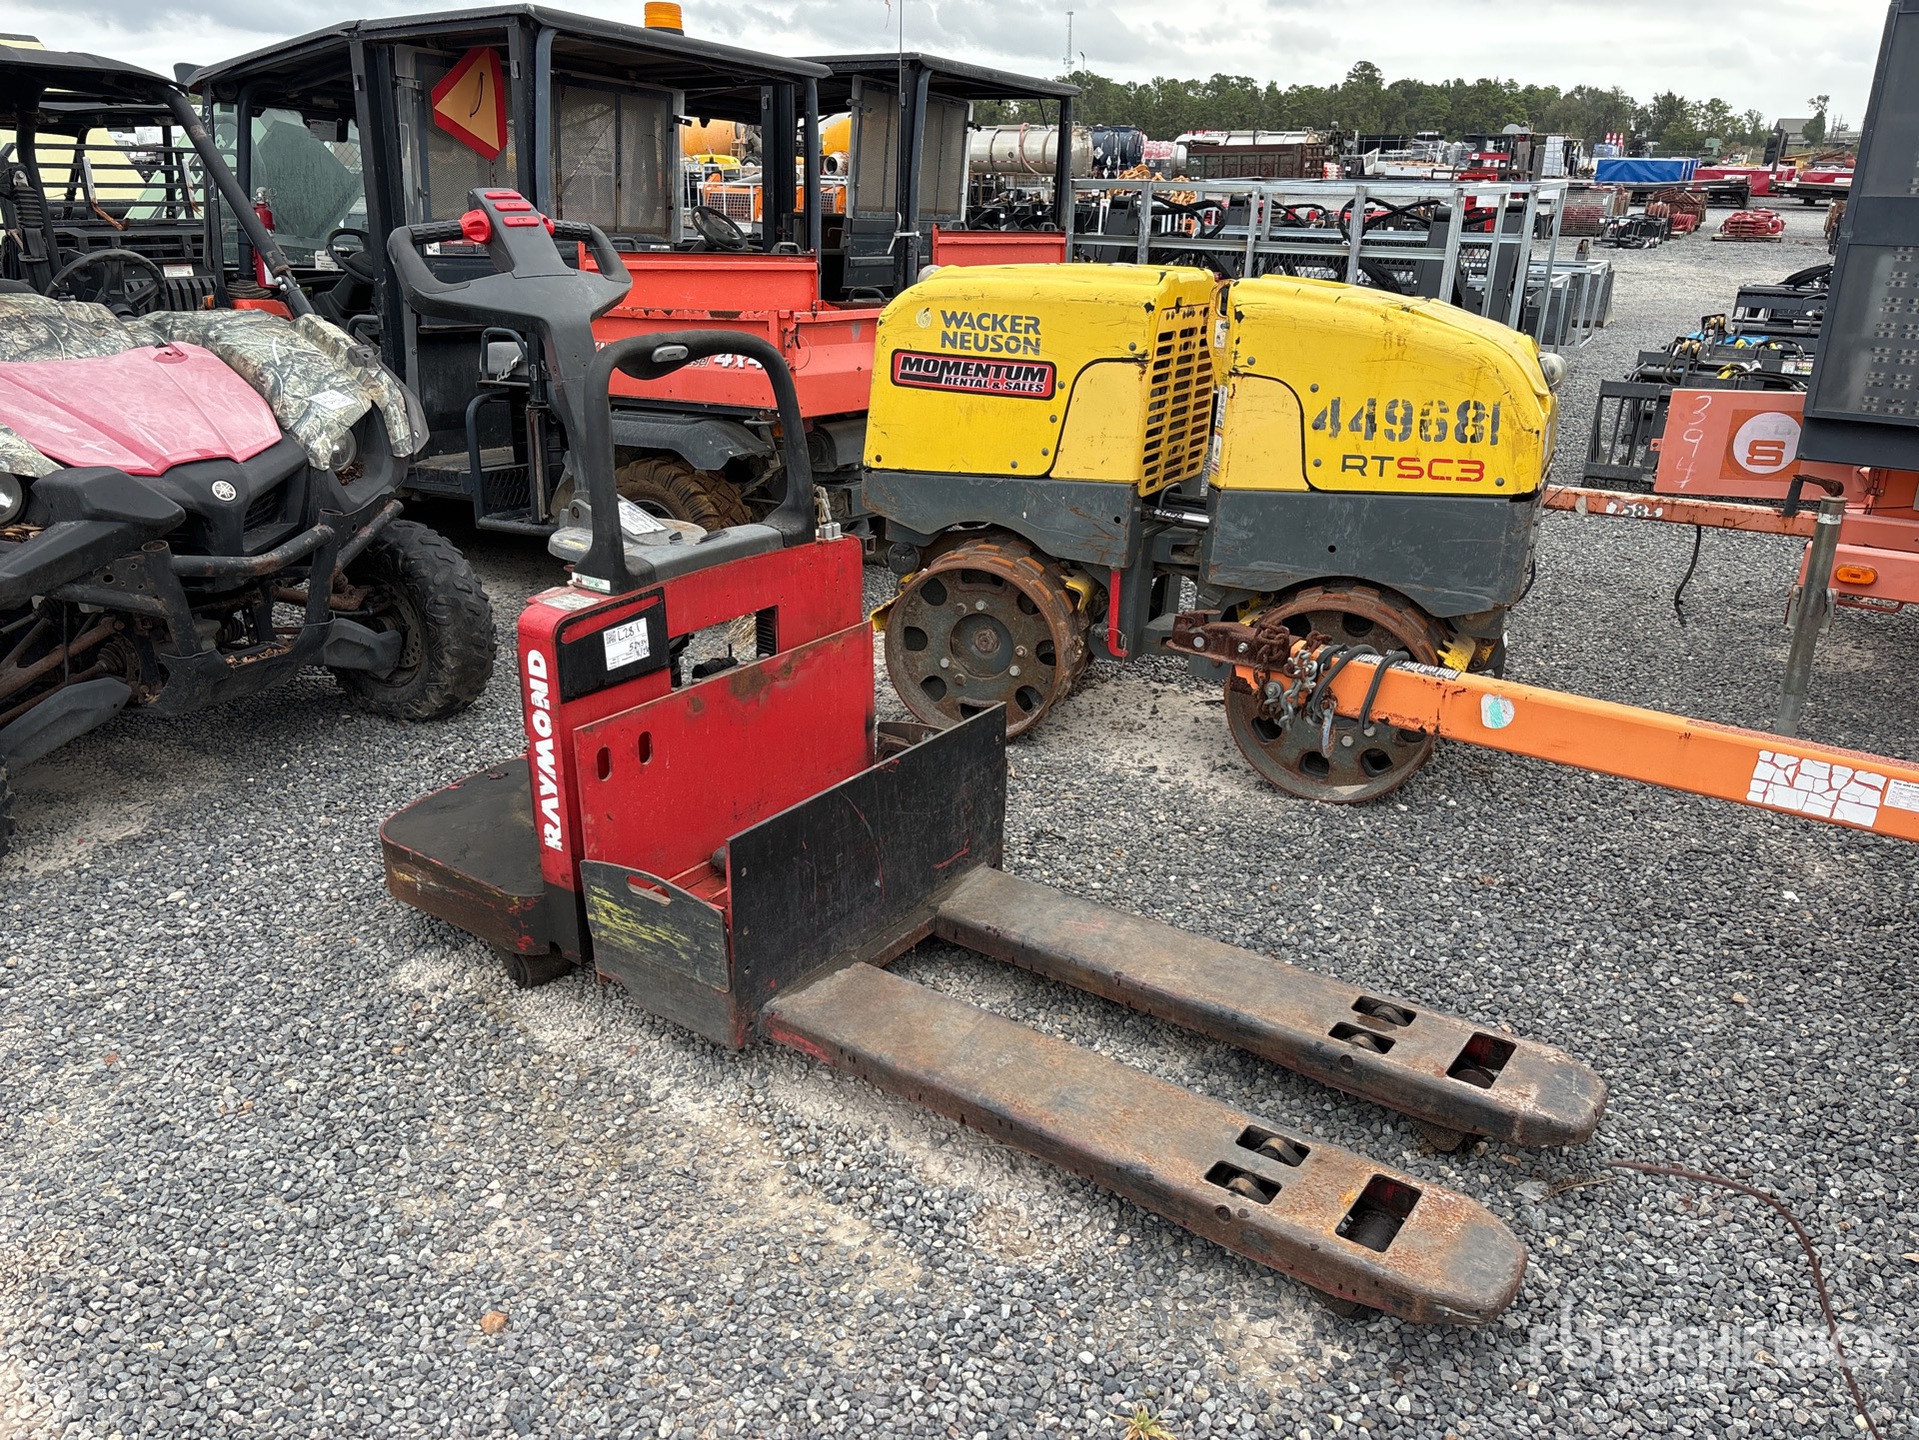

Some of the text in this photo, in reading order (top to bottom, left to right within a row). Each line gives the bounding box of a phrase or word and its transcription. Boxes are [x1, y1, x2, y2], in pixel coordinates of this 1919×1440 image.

[940, 309, 1041, 335] WACKER
[940, 331, 1041, 356] NEUSON
[898, 355, 1048, 385] MOMENTUM
[944, 376, 1044, 393] RENTAL & SALES
[1340, 454, 1486, 482] RTSC3
[527, 649, 563, 852] RAYMOND
